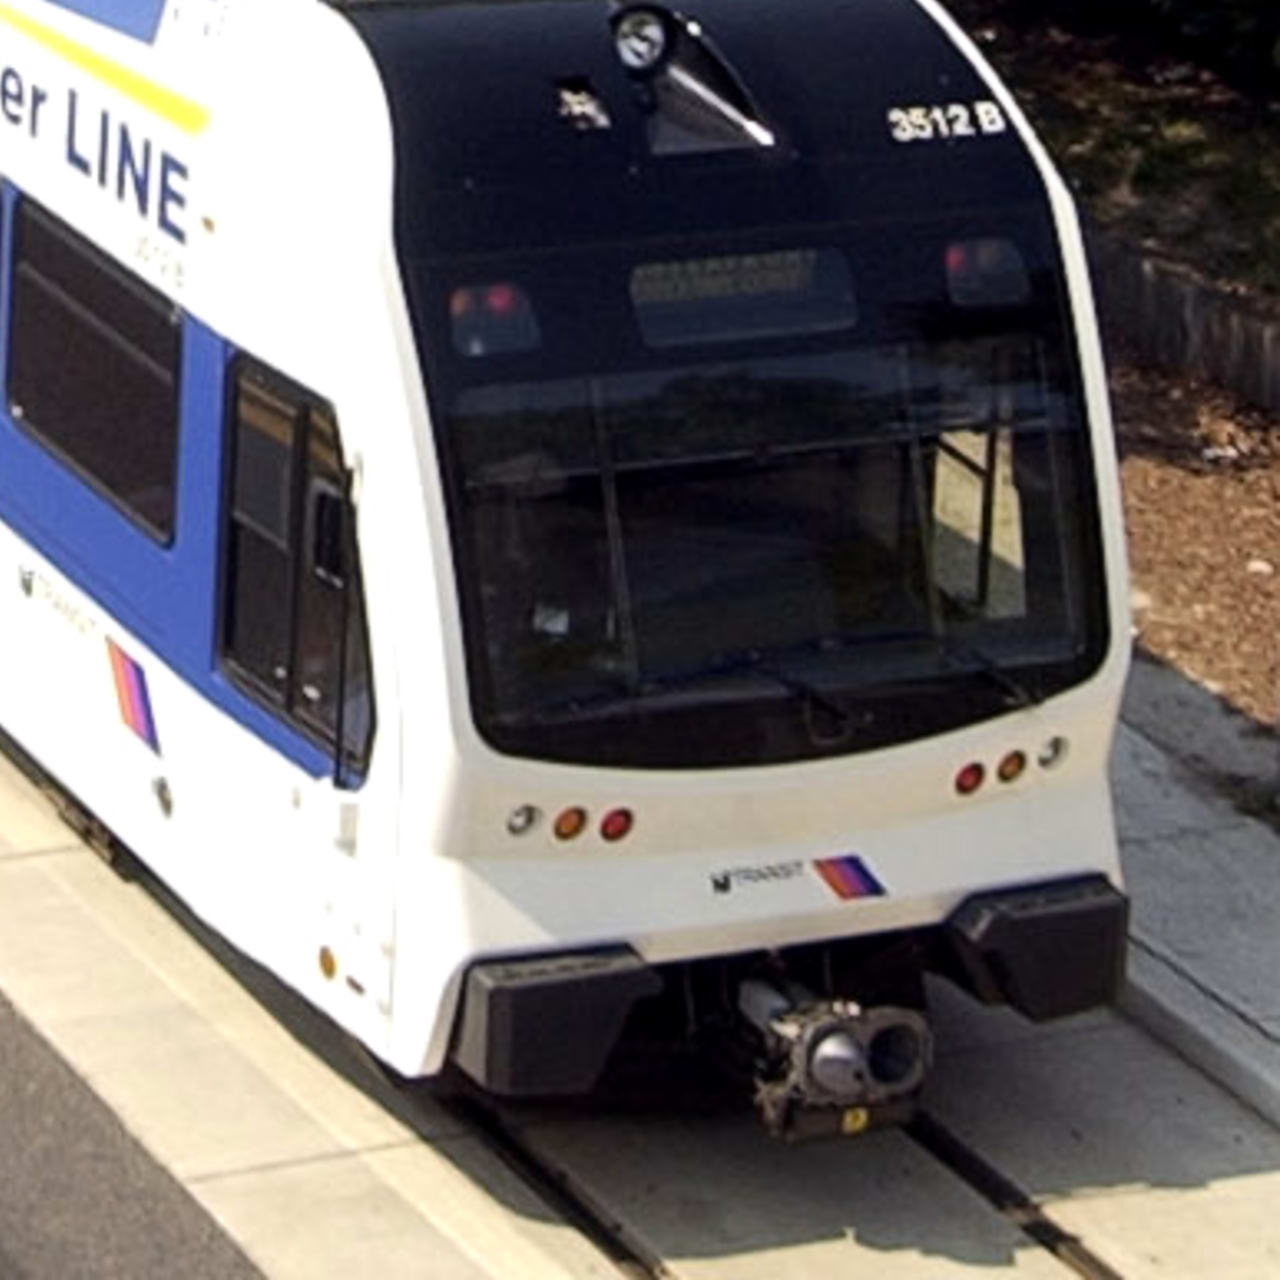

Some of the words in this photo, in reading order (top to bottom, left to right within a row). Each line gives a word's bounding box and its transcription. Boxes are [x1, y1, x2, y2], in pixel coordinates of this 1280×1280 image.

[66, 88, 190, 246] LINE
[888, 103, 976, 142] 3512
[974, 100, 1007, 134] B
